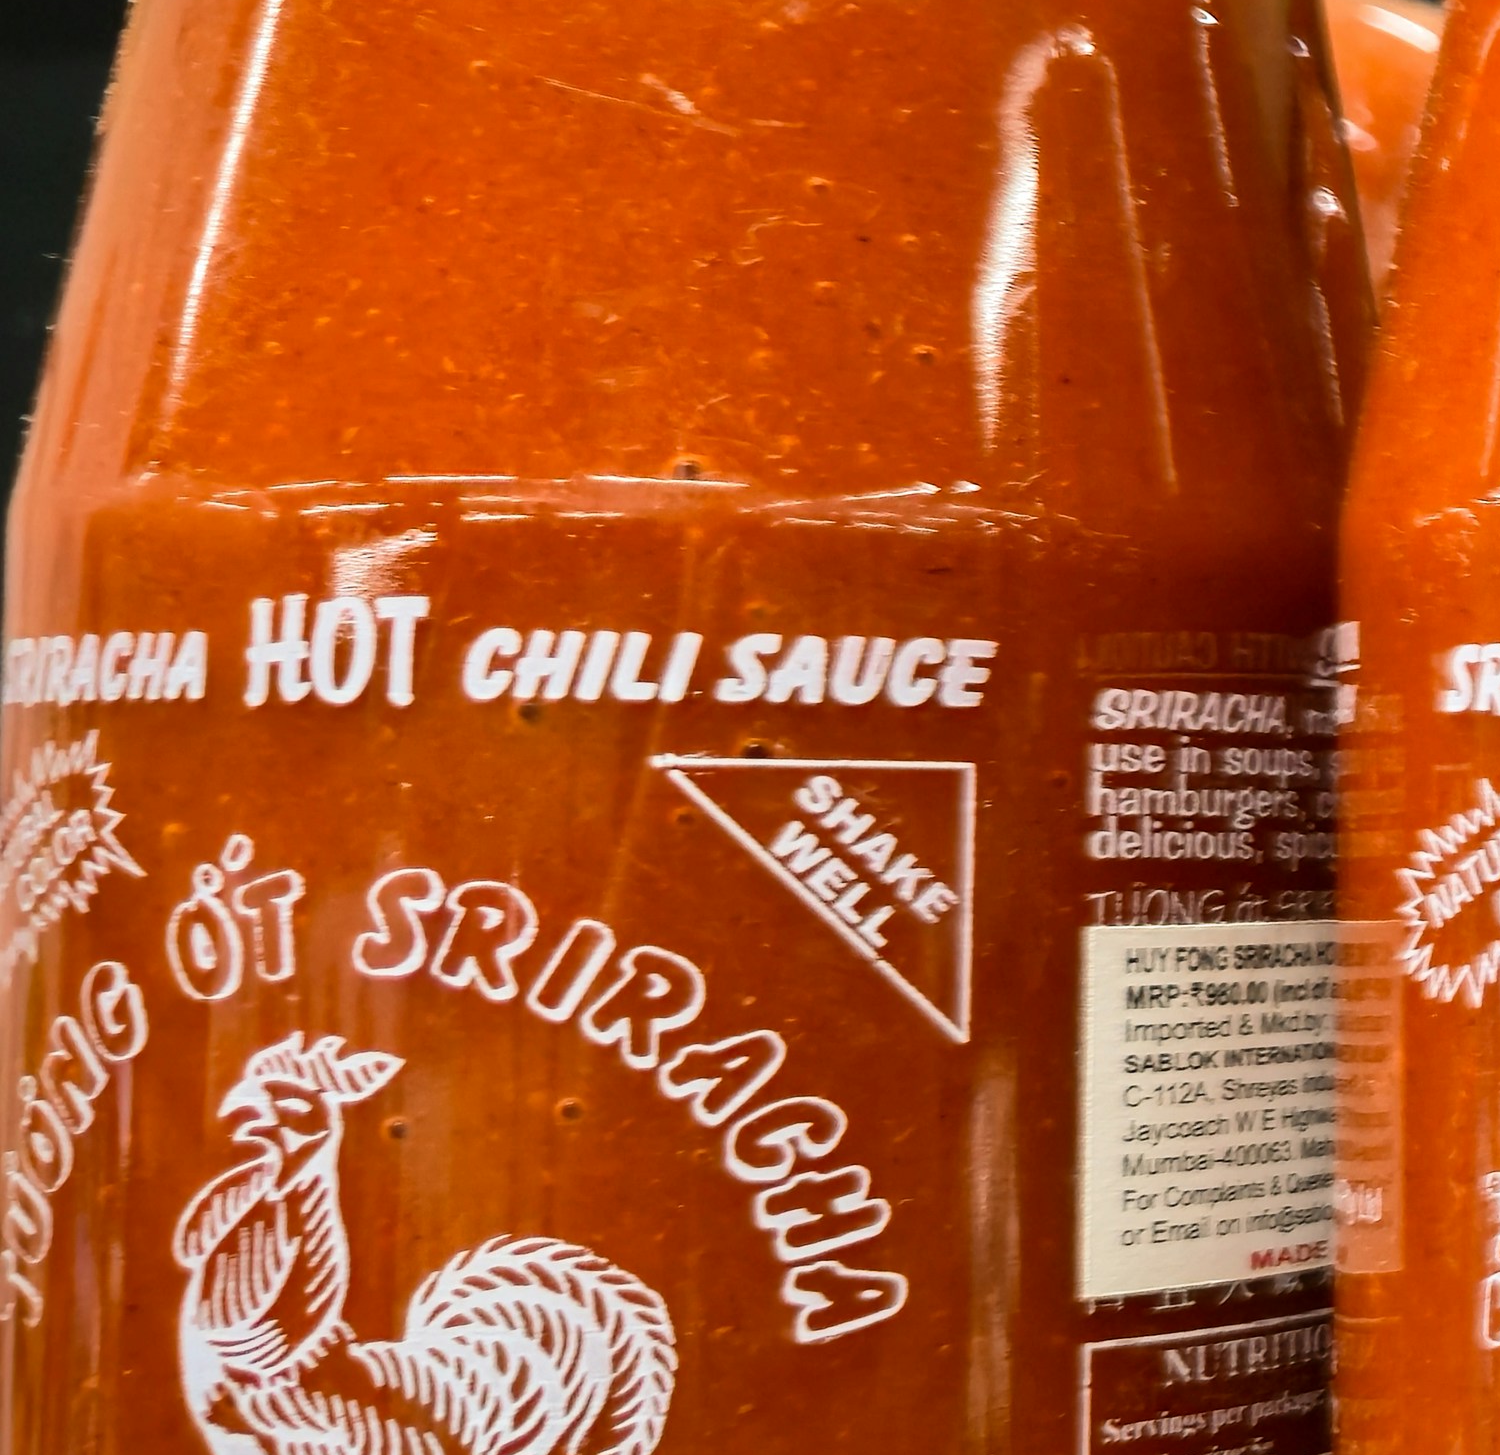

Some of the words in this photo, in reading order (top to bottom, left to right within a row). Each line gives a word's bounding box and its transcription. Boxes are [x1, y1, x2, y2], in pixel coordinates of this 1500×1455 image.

[245, 595, 430, 708] HOT
[462, 627, 703, 705] CHILI
[716, 635, 1000, 708] SAUCE
[1089, 744, 1166, 774] use
[1179, 736, 1212, 775] in
[1224, 747, 1320, 788] soups,
[1088, 771, 1306, 829] hamburgers,
[795, 774, 960, 925] SHAKE
[1087, 816, 1264, 864] delicious,
[771, 821, 892, 949] WELL
[1125, 948, 1168, 973] HUY
[1124, 1015, 1232, 1042] Imported
[1123, 1049, 1219, 1074] SABLOK
[353, 866, 908, 1344] SRIRACHA
[1122, 1116, 1229, 1145] Jaycoach
[1121, 1190, 1157, 1212] For
[1250, 1241, 1328, 1270] MADE
[1101, 1411, 1206, 1444] Servings
